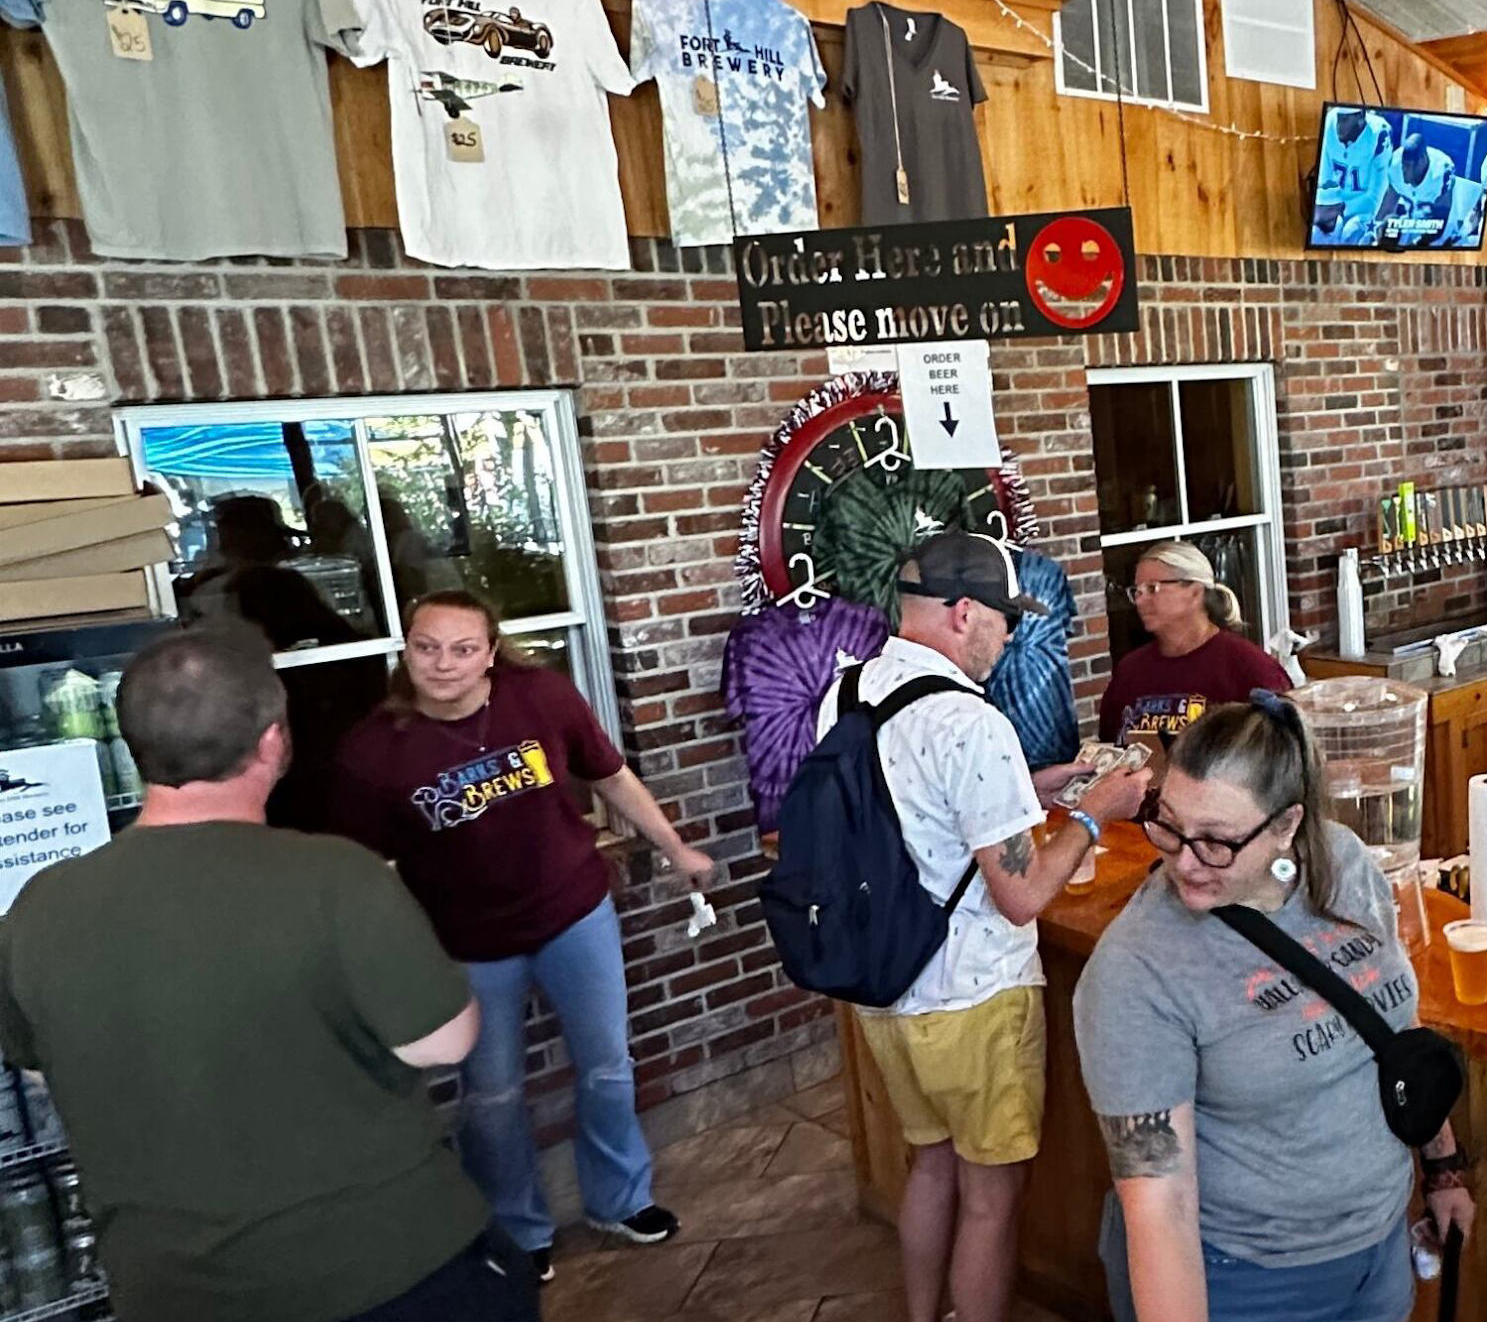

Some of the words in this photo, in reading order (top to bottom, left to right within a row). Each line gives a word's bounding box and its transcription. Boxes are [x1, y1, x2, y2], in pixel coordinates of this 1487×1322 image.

[680, 35, 720, 52] FORT
[754, 44, 785, 66] HILL
[682, 52, 785, 82] BREWERY
[742, 237, 843, 287] Order
[852, 234, 941, 280] Here
[952, 222, 1019, 275] and
[757, 299, 867, 346] Please
[875, 302, 969, 340] move
[980, 300, 1025, 334] on
[923, 353, 961, 365] ORDER
[929, 369, 958, 380] BEER
[930, 384, 960, 395] HERE
[436, 759, 502, 797] BARKS
[462, 768, 536, 812] BREWS
[42, 801, 77, 817] see
[64, 821, 89, 835] for
